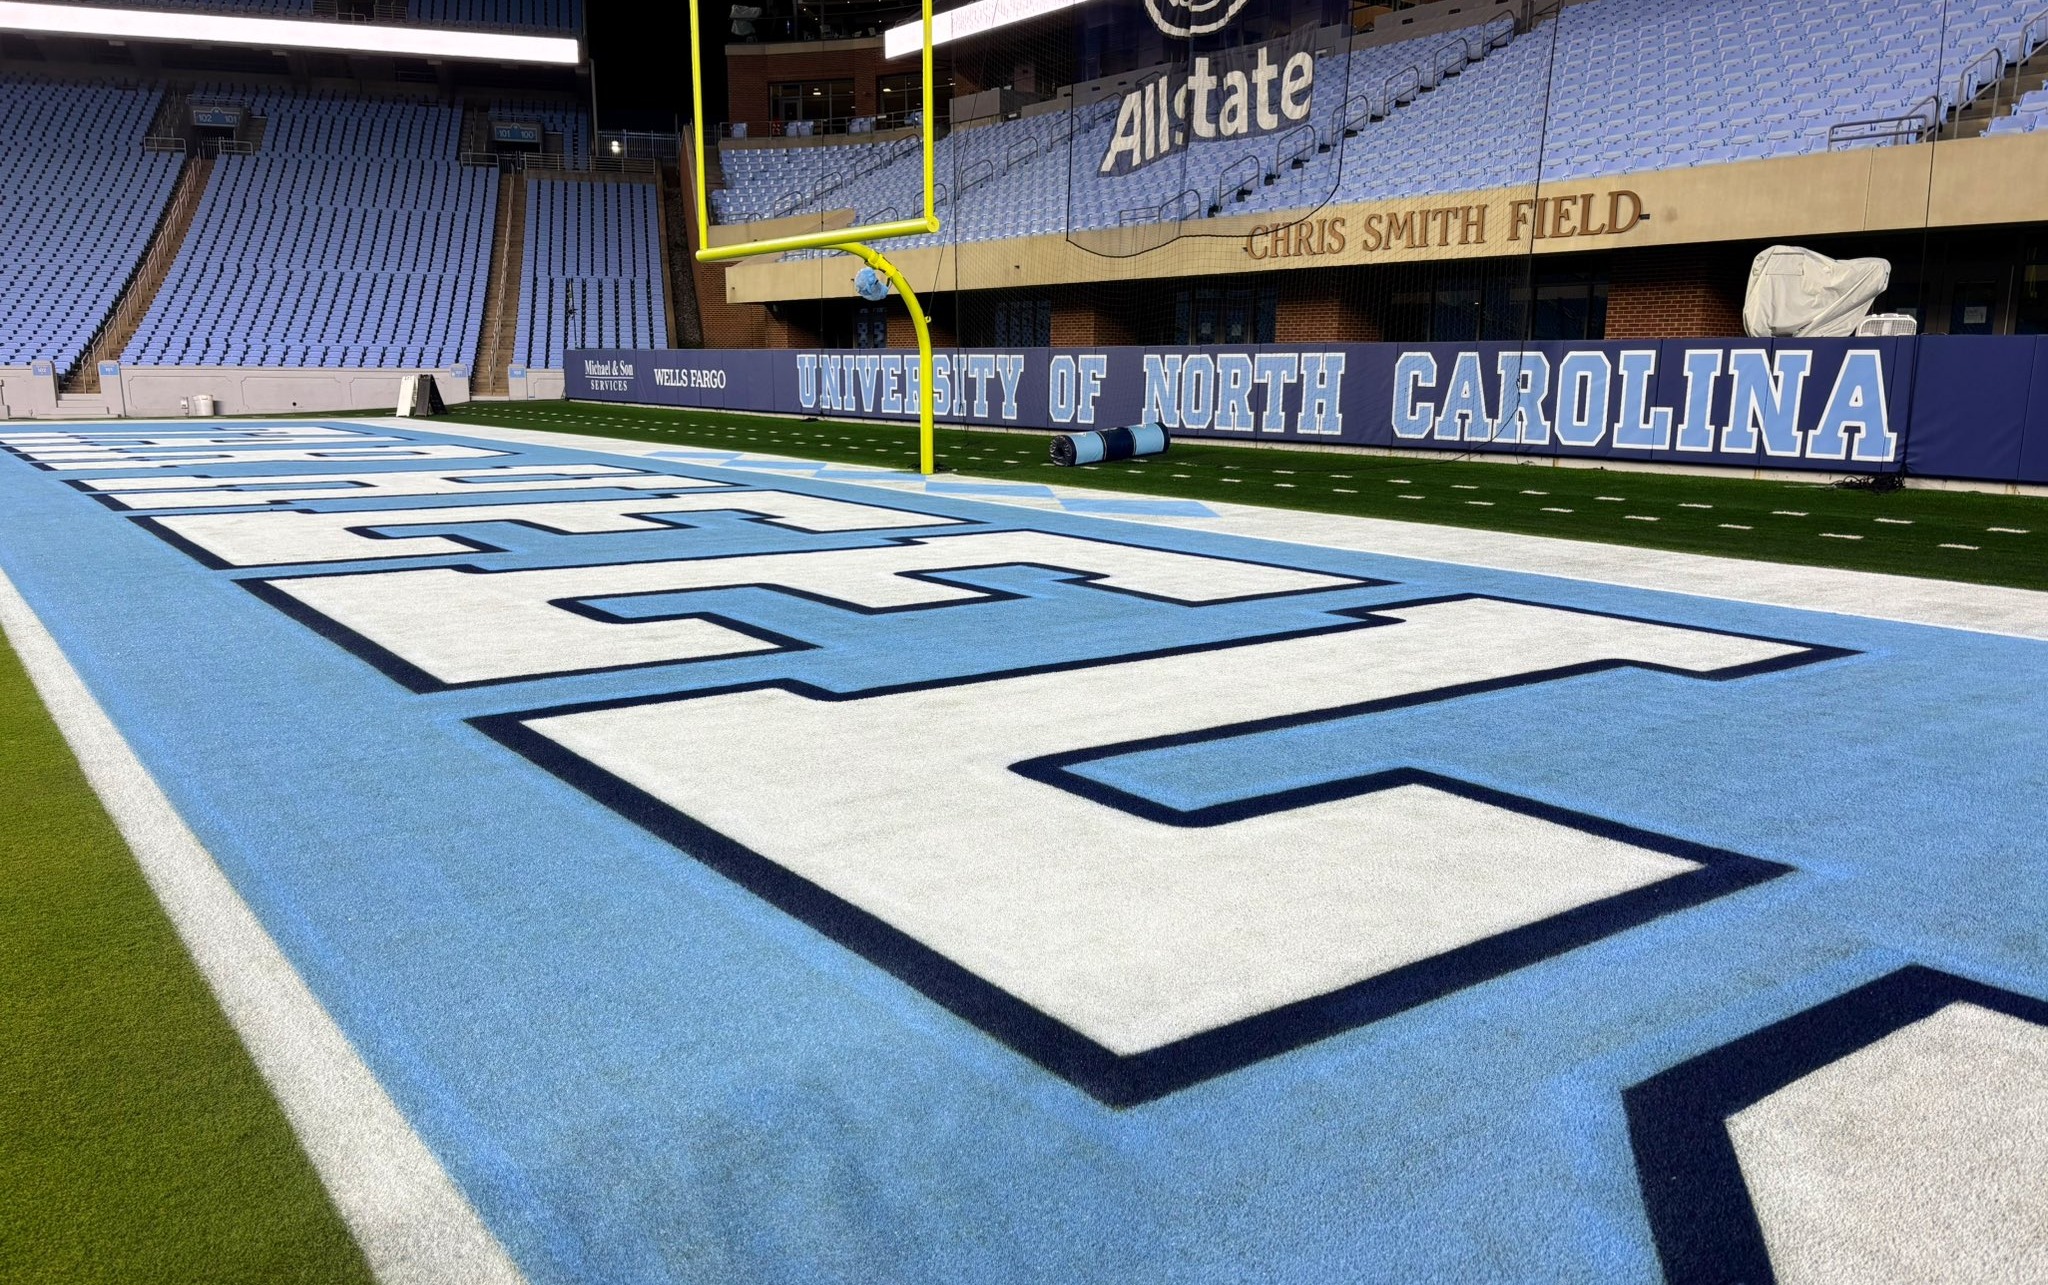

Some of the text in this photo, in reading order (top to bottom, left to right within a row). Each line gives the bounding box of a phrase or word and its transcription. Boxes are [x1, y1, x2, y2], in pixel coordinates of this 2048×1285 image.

[1246, 189, 1643, 260] CHRIS SMITH FIELD
[585, 360, 634, 376] Michael & Son
[590, 379, 628, 391] SERVICES
[654, 368, 727, 389] WELLS FARGO
[796, 348, 1898, 463] UNIVERSITY OF NORTH CAROLINA
[60, 463, 2048, 1285] HEEL
